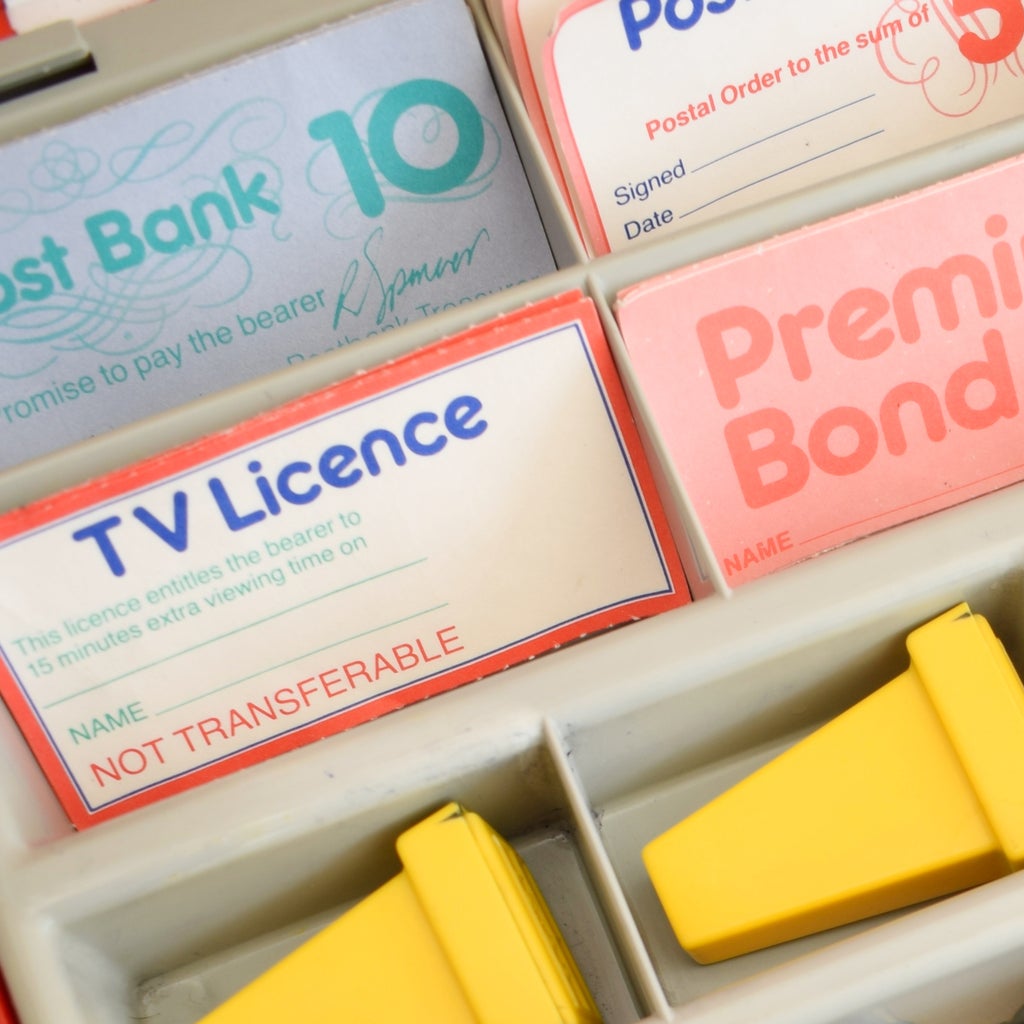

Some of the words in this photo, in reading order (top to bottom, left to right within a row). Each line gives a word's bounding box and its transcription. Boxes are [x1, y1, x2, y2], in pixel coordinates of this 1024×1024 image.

[645, 94, 717, 141] Postal
[720, 67, 783, 106] Order
[787, 57, 811, 77] to
[814, 41, 851, 66] the
[855, 19, 904, 49] sum
[908, 4, 930, 28] of
[308, 78, 485, 218] 10
[614, 159, 686, 207] Signed
[83, 165, 281, 274] Bank
[623, 208, 674, 241] Date
[99, 363, 129, 386] to
[132, 343, 183, 380] pay
[187, 324, 234, 355] the
[236, 288, 326, 336] bearer
[72, 491, 188, 577] TV
[208, 395, 488, 532] Licence
[723, 327, 1020, 510] Bond
[11, 629, 62, 657] This
[63, 595, 143, 638] licence
[146, 564, 224, 605] entitles
[225, 548, 262, 573] the
[264, 521, 335, 558] bearer
[339, 510, 362, 529] to
[28, 656, 52, 679] 15
[58, 622, 143, 670] minutes
[146, 600, 201, 632] extra
[204, 567, 287, 609] viewing
[288, 547, 336, 576] time
[340, 534, 368, 557] on
[722, 530, 794, 577] NAME
[68, 701, 149, 745] NAME
[89, 737, 165, 788] NOT
[172, 625, 465, 756] TRANSFERABLE
